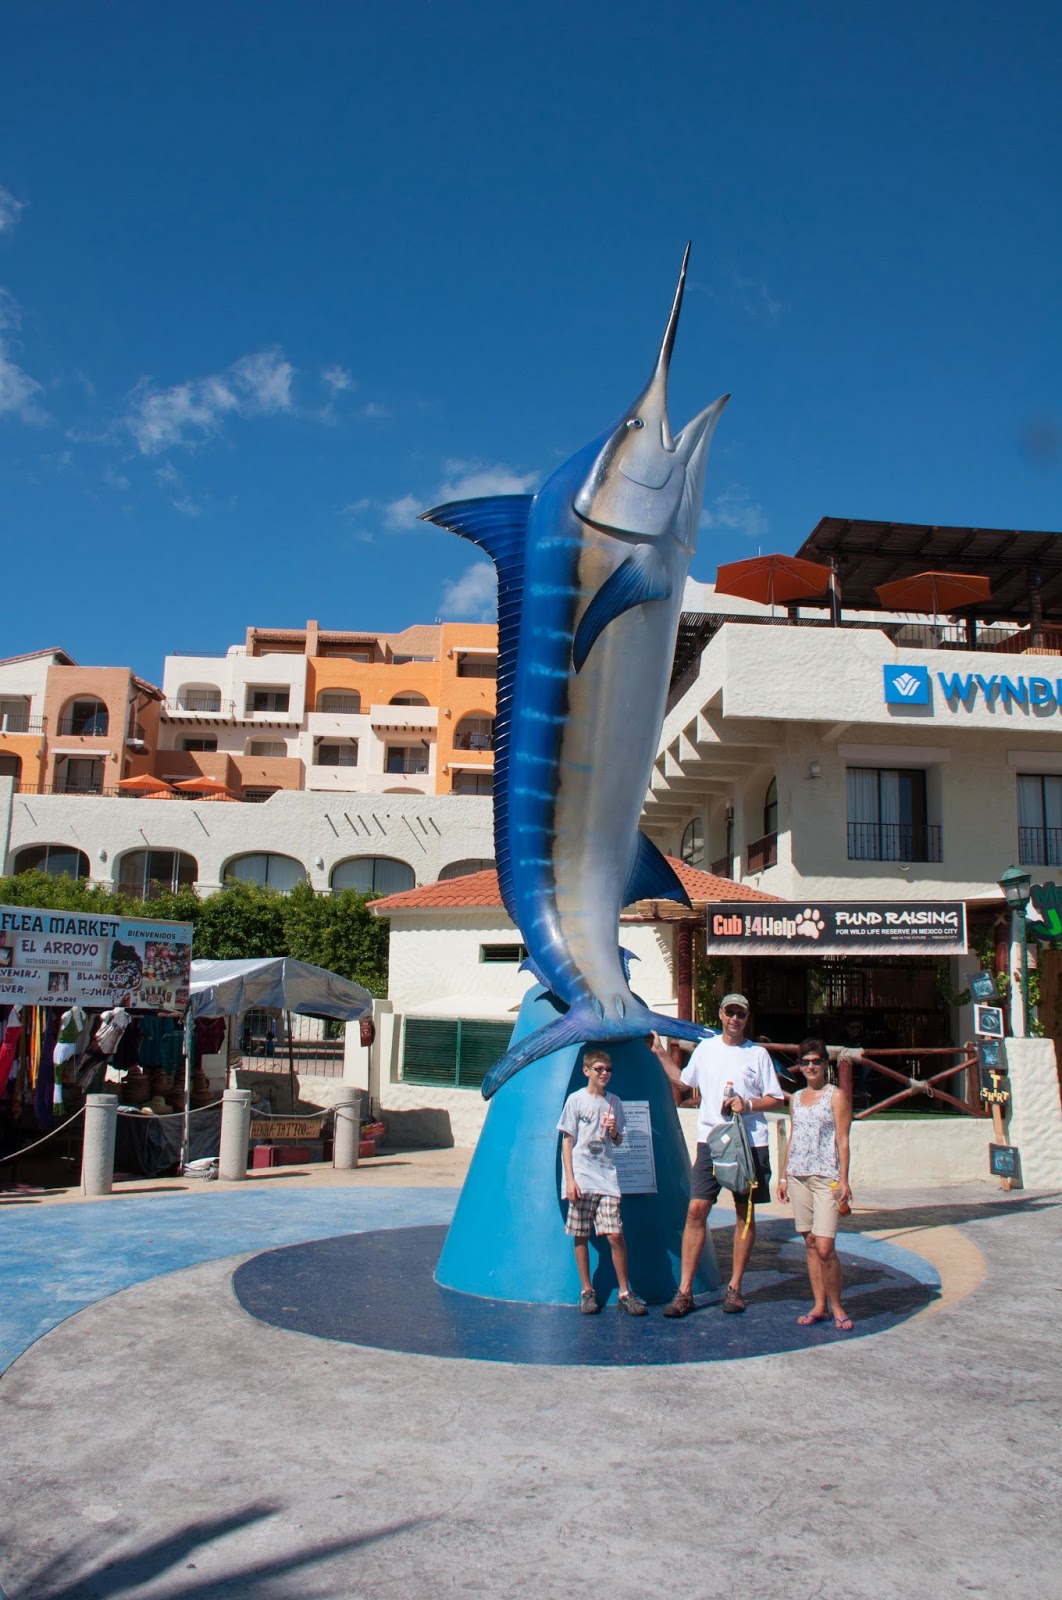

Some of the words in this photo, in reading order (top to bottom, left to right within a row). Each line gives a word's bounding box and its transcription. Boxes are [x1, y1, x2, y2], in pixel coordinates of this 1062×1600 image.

[1, 913, 44, 932] FLEA
[49, 917, 120, 938] MARKET
[713, 914, 743, 936] Cub
[835, 911, 883, 926] FUND
[884, 911, 959, 927] RAISING
[127, 930, 176, 940] BIENVENIDOS
[21, 939, 37, 953] EL
[43, 940, 99, 957] ARROYO
[61, 958, 69, 966] en
[71, 959, 93, 967] general
[0, 968, 41, 980] VENIRS,
[56, 996, 78, 1004] MORE
[990, 1073, 1001, 1089] T
[982, 1086, 1010, 1103] SHIRT
